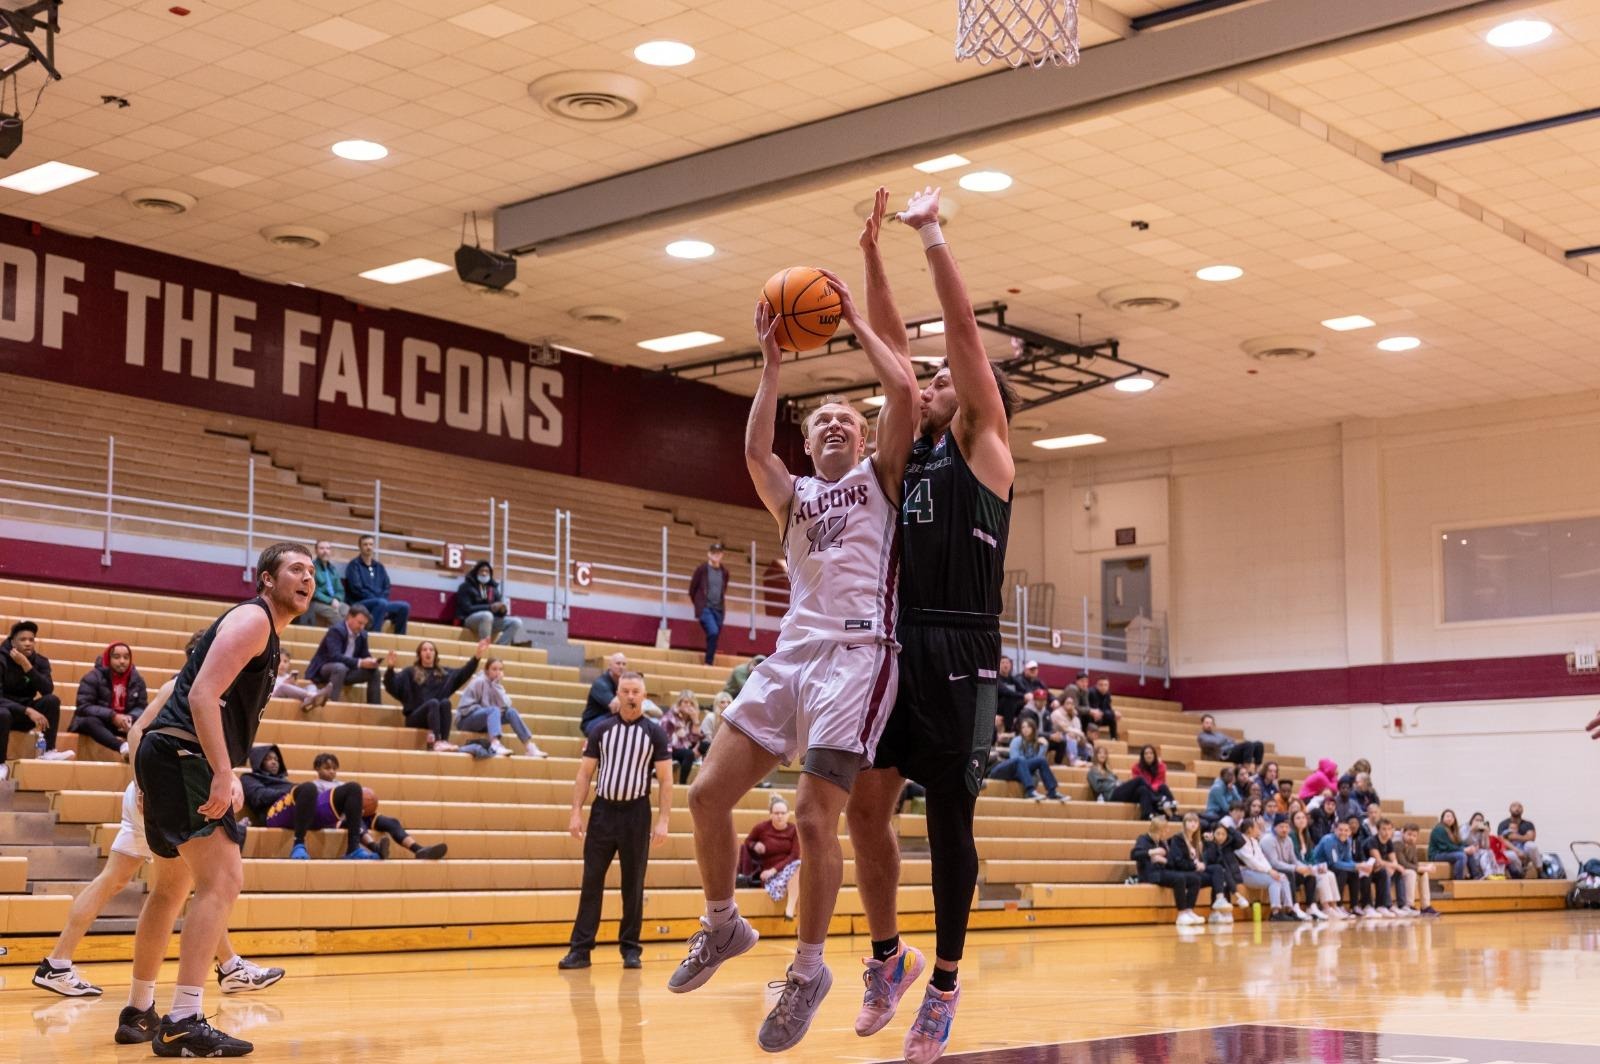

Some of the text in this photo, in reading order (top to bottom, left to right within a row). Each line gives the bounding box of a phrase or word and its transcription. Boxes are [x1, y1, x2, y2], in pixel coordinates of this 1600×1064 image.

[0, 243, 563, 448] OF THE FALCONS
[791, 485, 868, 527] ALCONS
[903, 478, 934, 525] 4
[449, 549, 462, 568] B
[577, 567, 591, 586] C
[1052, 633, 1061, 648] D
